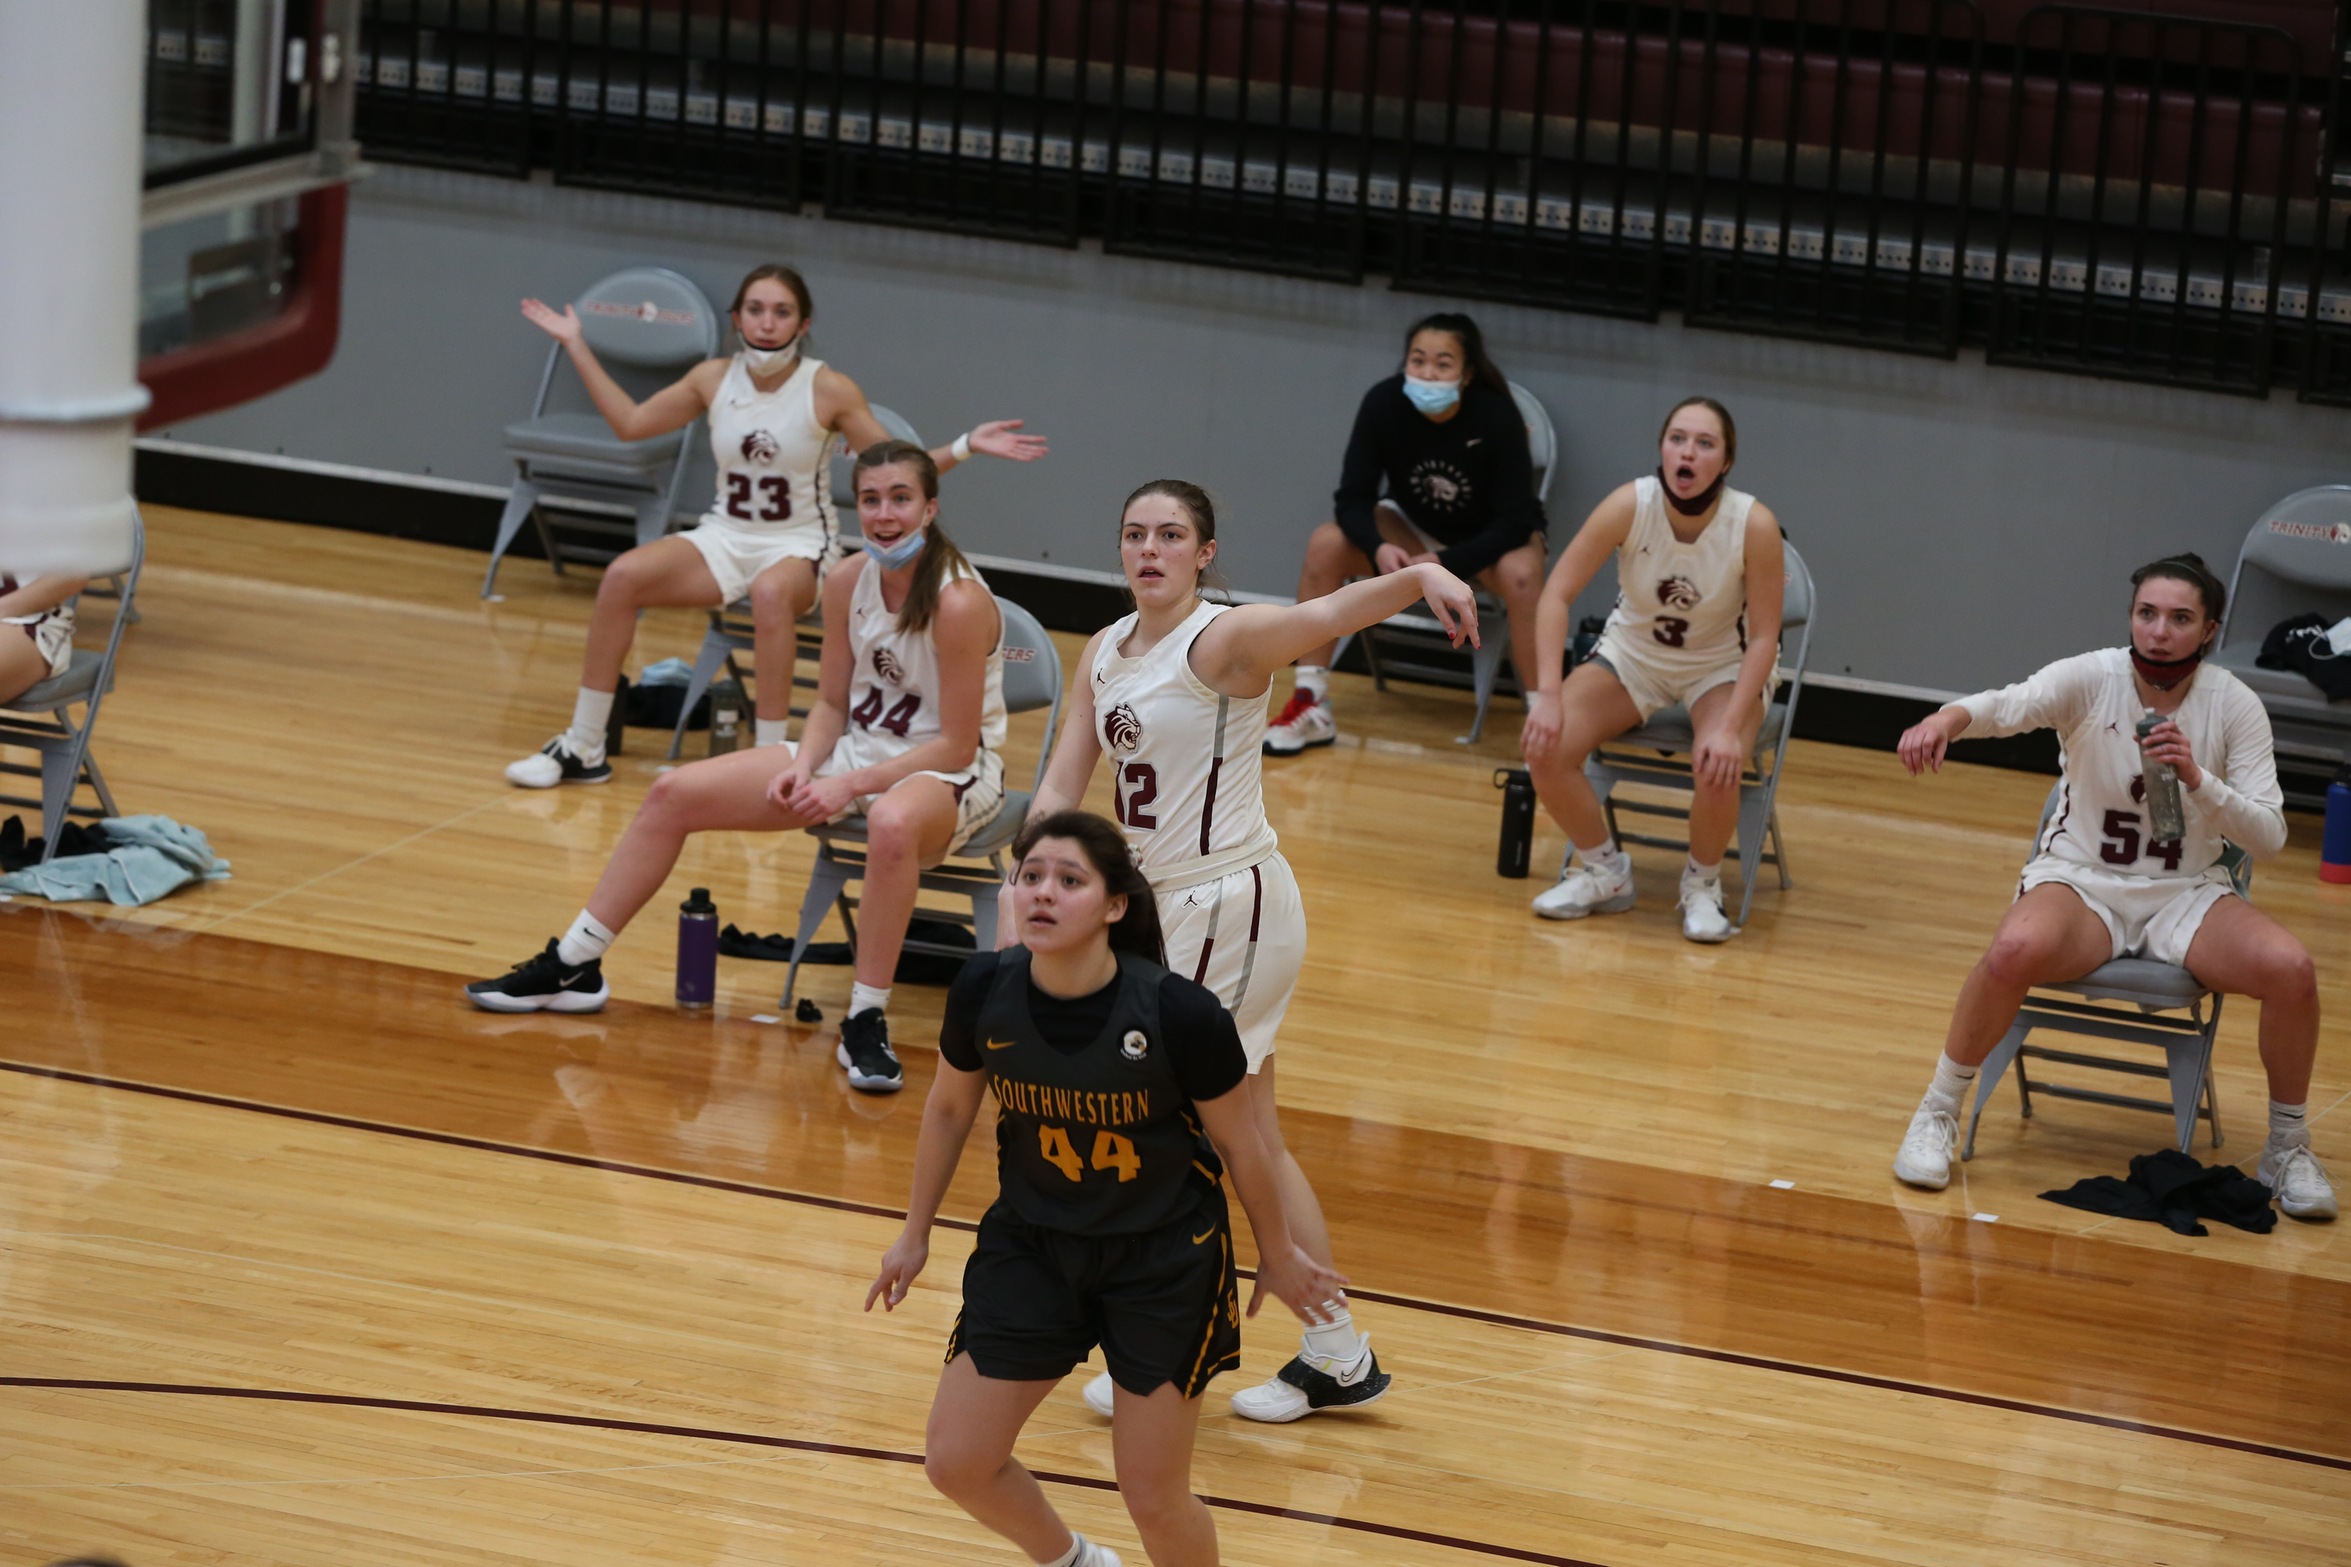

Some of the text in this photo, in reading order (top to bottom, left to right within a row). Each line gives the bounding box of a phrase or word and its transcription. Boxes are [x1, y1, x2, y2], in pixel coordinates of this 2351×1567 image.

[727, 473, 792, 522] 23
[2270, 520, 2328, 541] TRINITY
[1653, 615, 1689, 648] 3
[852, 685, 922, 737] 44
[1114, 760, 1158, 831] 12
[2100, 809, 2184, 871] 54
[993, 1073, 1150, 1127] SOUTHWESTERN
[1038, 1123, 1142, 1183] 44
